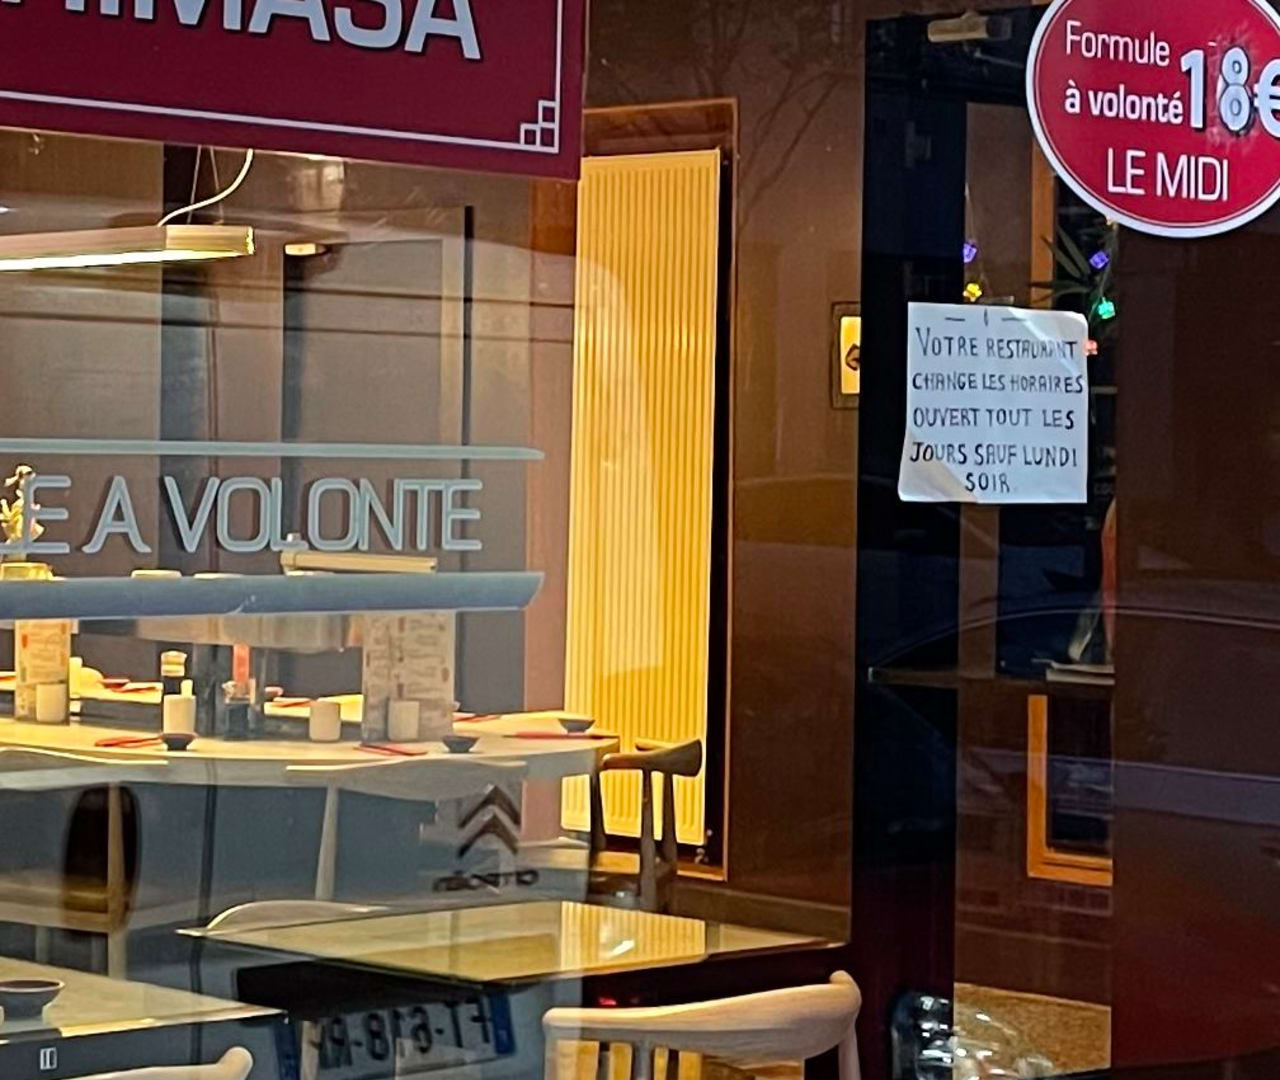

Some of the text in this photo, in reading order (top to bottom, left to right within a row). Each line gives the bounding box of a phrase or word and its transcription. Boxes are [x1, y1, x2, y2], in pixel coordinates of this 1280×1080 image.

[1066, 20, 1170, 67] Formule
[1065, 79, 1184, 125] à volonté
[1107, 147, 1228, 202] LE MIDI
[915, 327, 978, 358] VOTRE
[912, 372, 1083, 394] CHANGE LES HORAIRES
[913, 407, 1075, 430] OUVERT TOUT LES
[910, 441, 1078, 468] JOURS SAUF LUNDI
[81, 475, 151, 553] A
[164, 475, 482, 553] VOLONTE
